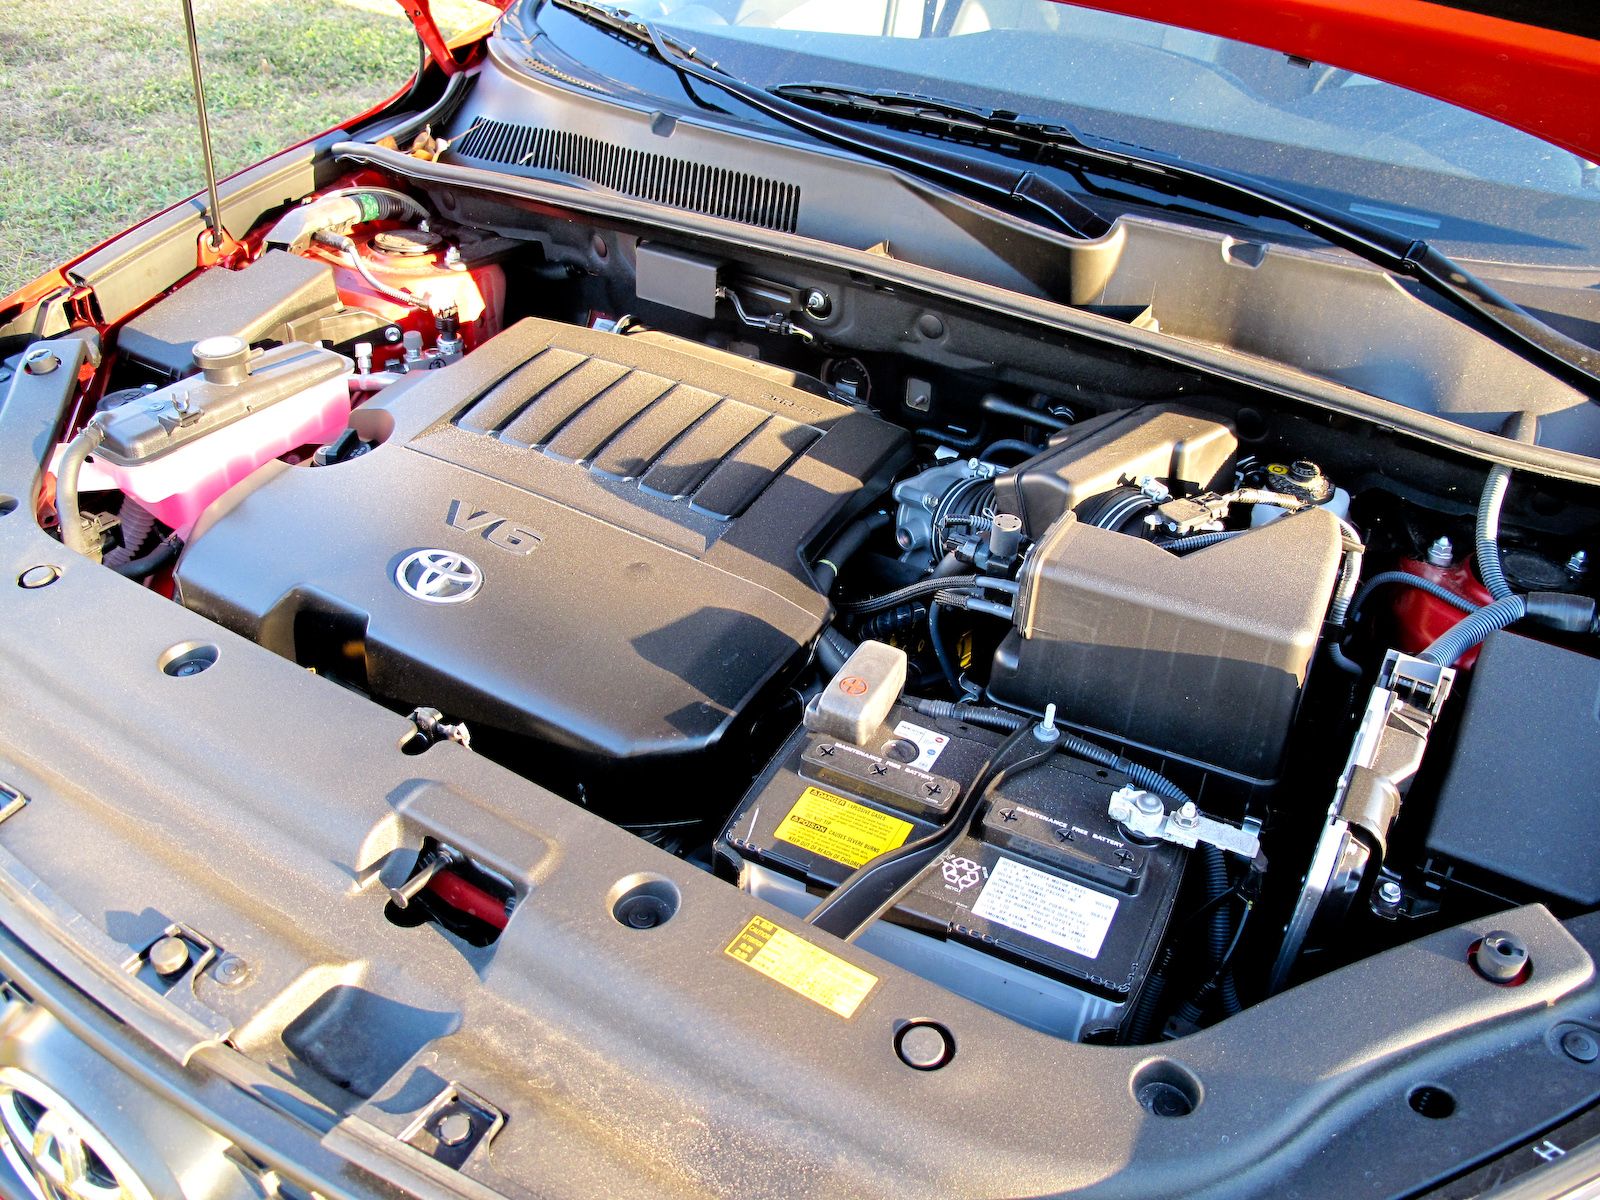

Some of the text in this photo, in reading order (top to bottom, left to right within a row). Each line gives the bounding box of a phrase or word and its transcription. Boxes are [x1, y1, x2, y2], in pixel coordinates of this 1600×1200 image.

[445, 498, 543, 556] V6
[834, 742, 934, 780] MAINTENANCE FREE BATTERY
[817, 792, 846, 805] DANGER
[797, 818, 826, 832] POISON
[1016, 806, 1125, 848] MAINTENANCE FREE BATTERY
